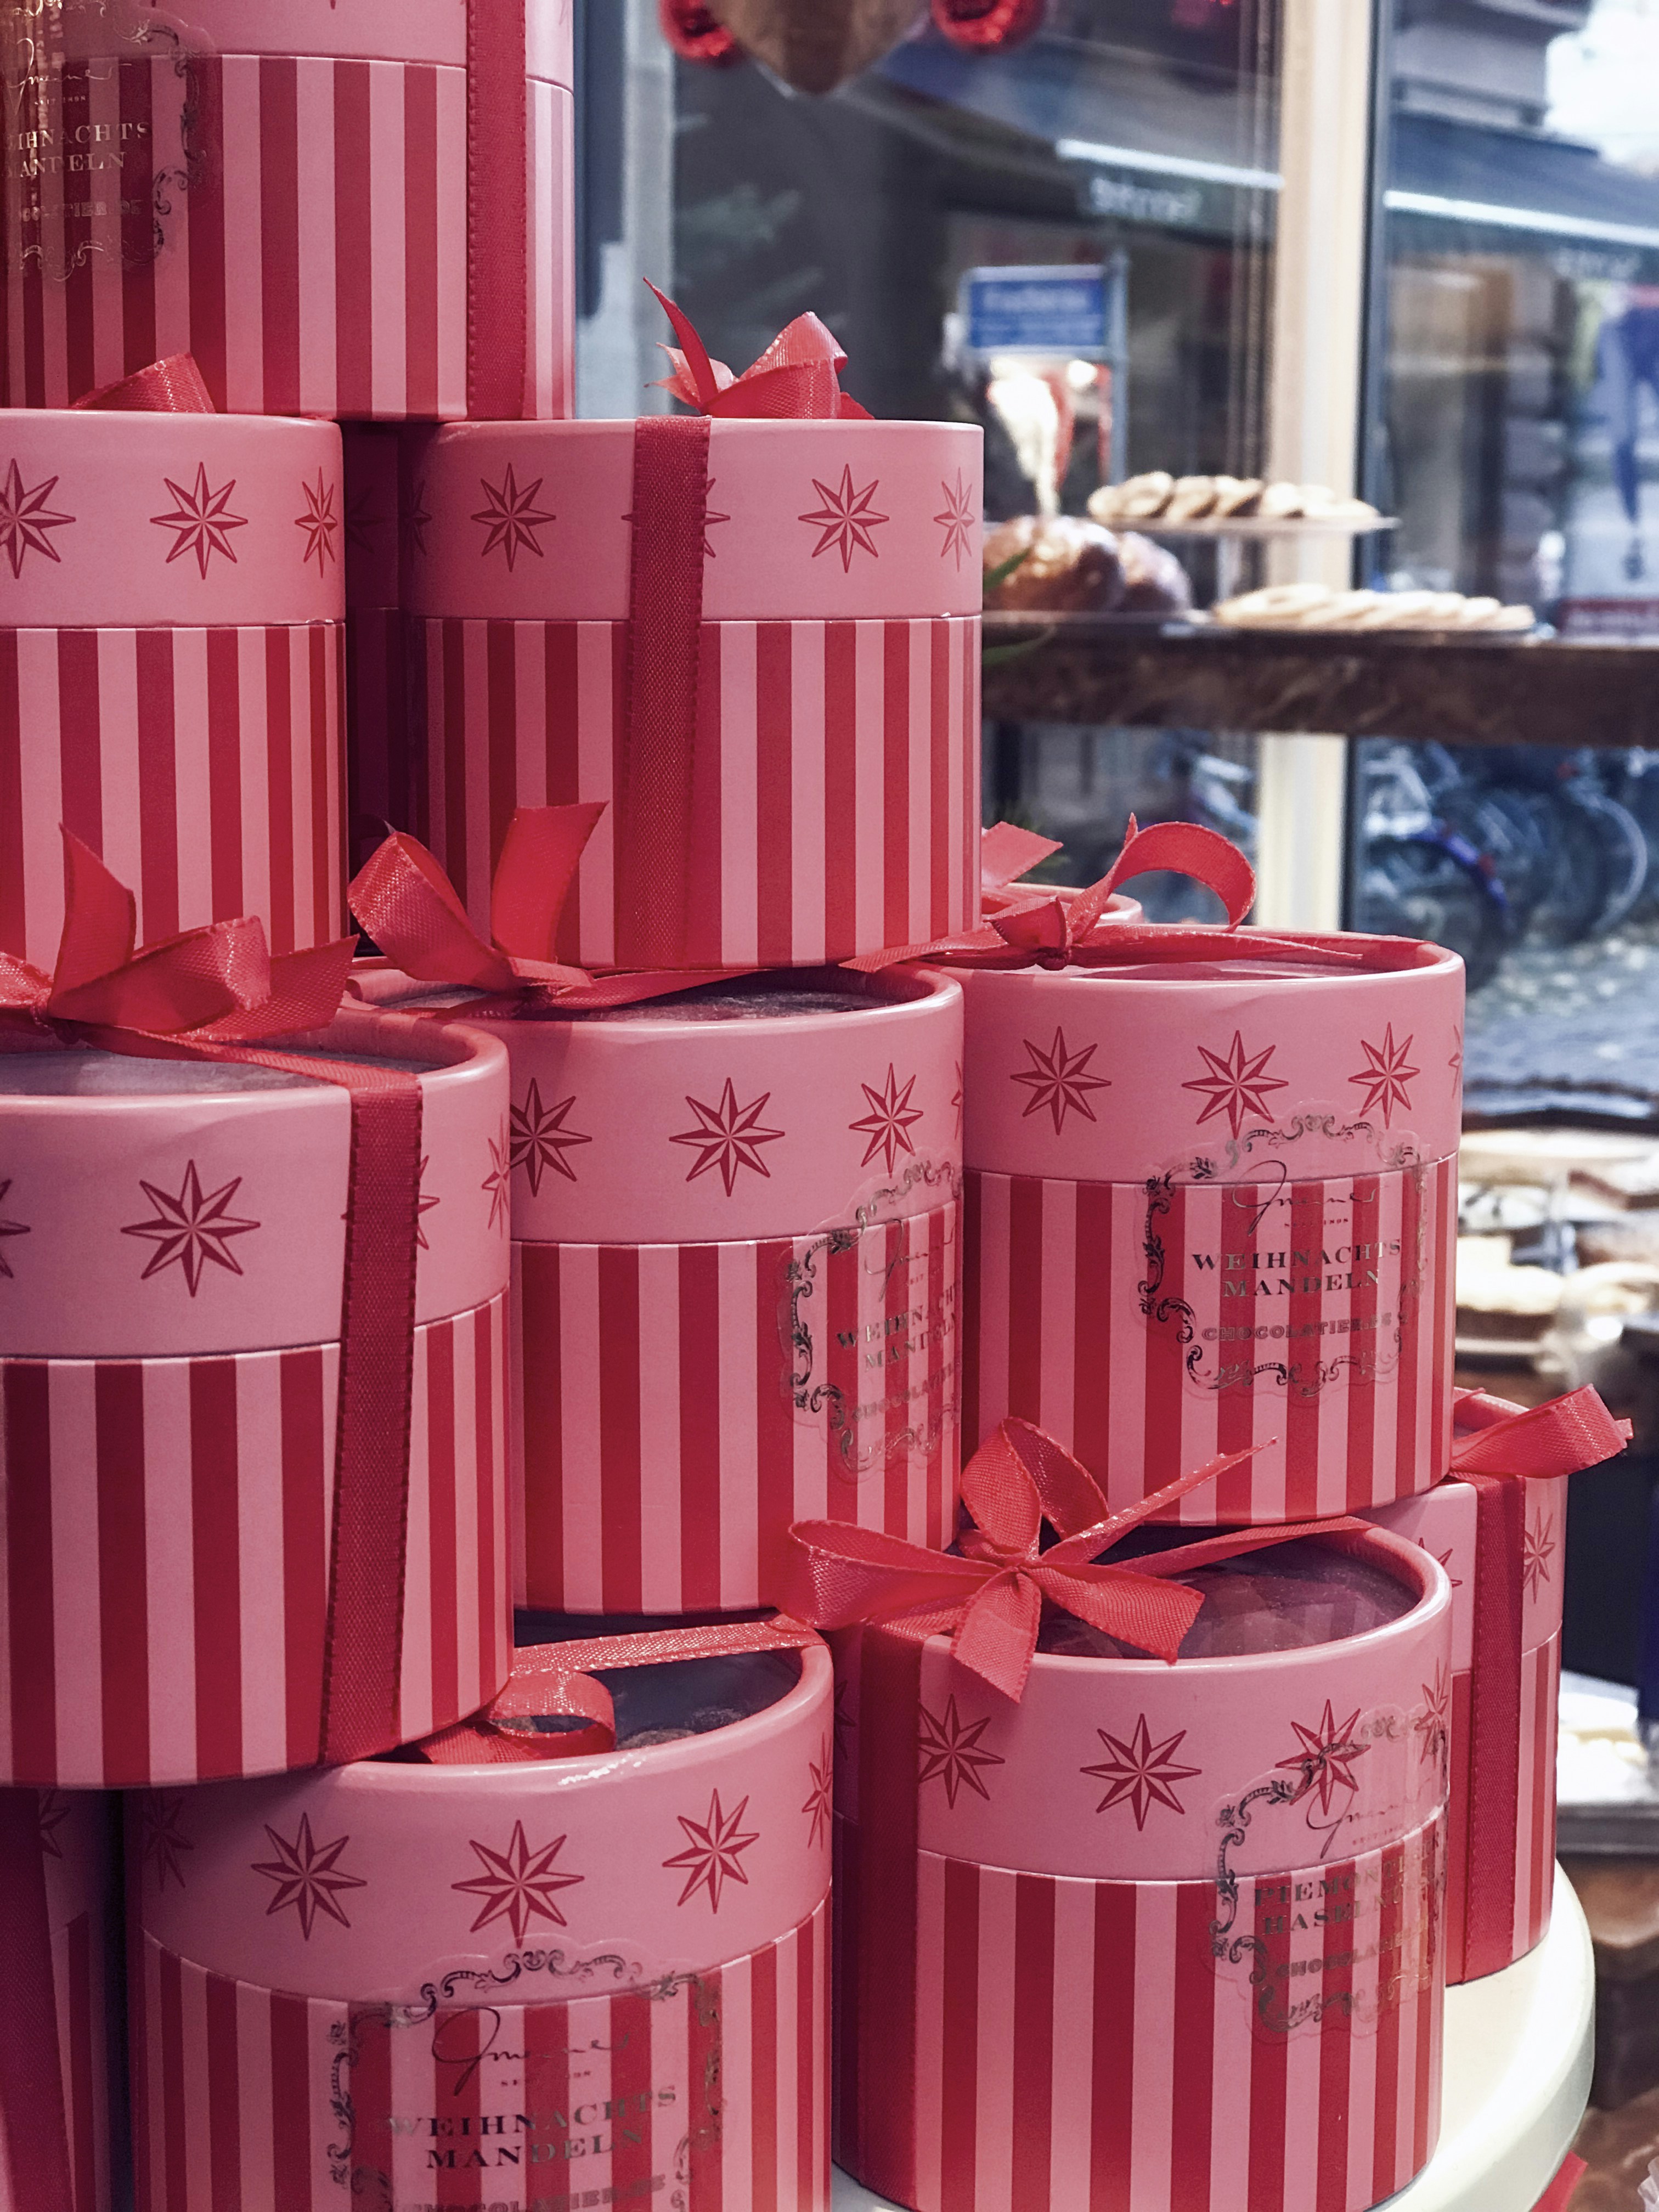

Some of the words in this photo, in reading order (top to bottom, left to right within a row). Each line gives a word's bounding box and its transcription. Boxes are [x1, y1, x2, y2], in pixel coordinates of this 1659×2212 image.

[1192, 1239, 1401, 1271] WEIHNACHTS
[1222, 1269, 1380, 1297] MANDELN
[389, 2085, 676, 2137] WEIHNACHTS
[426, 2127, 642, 2169] MANDELN
